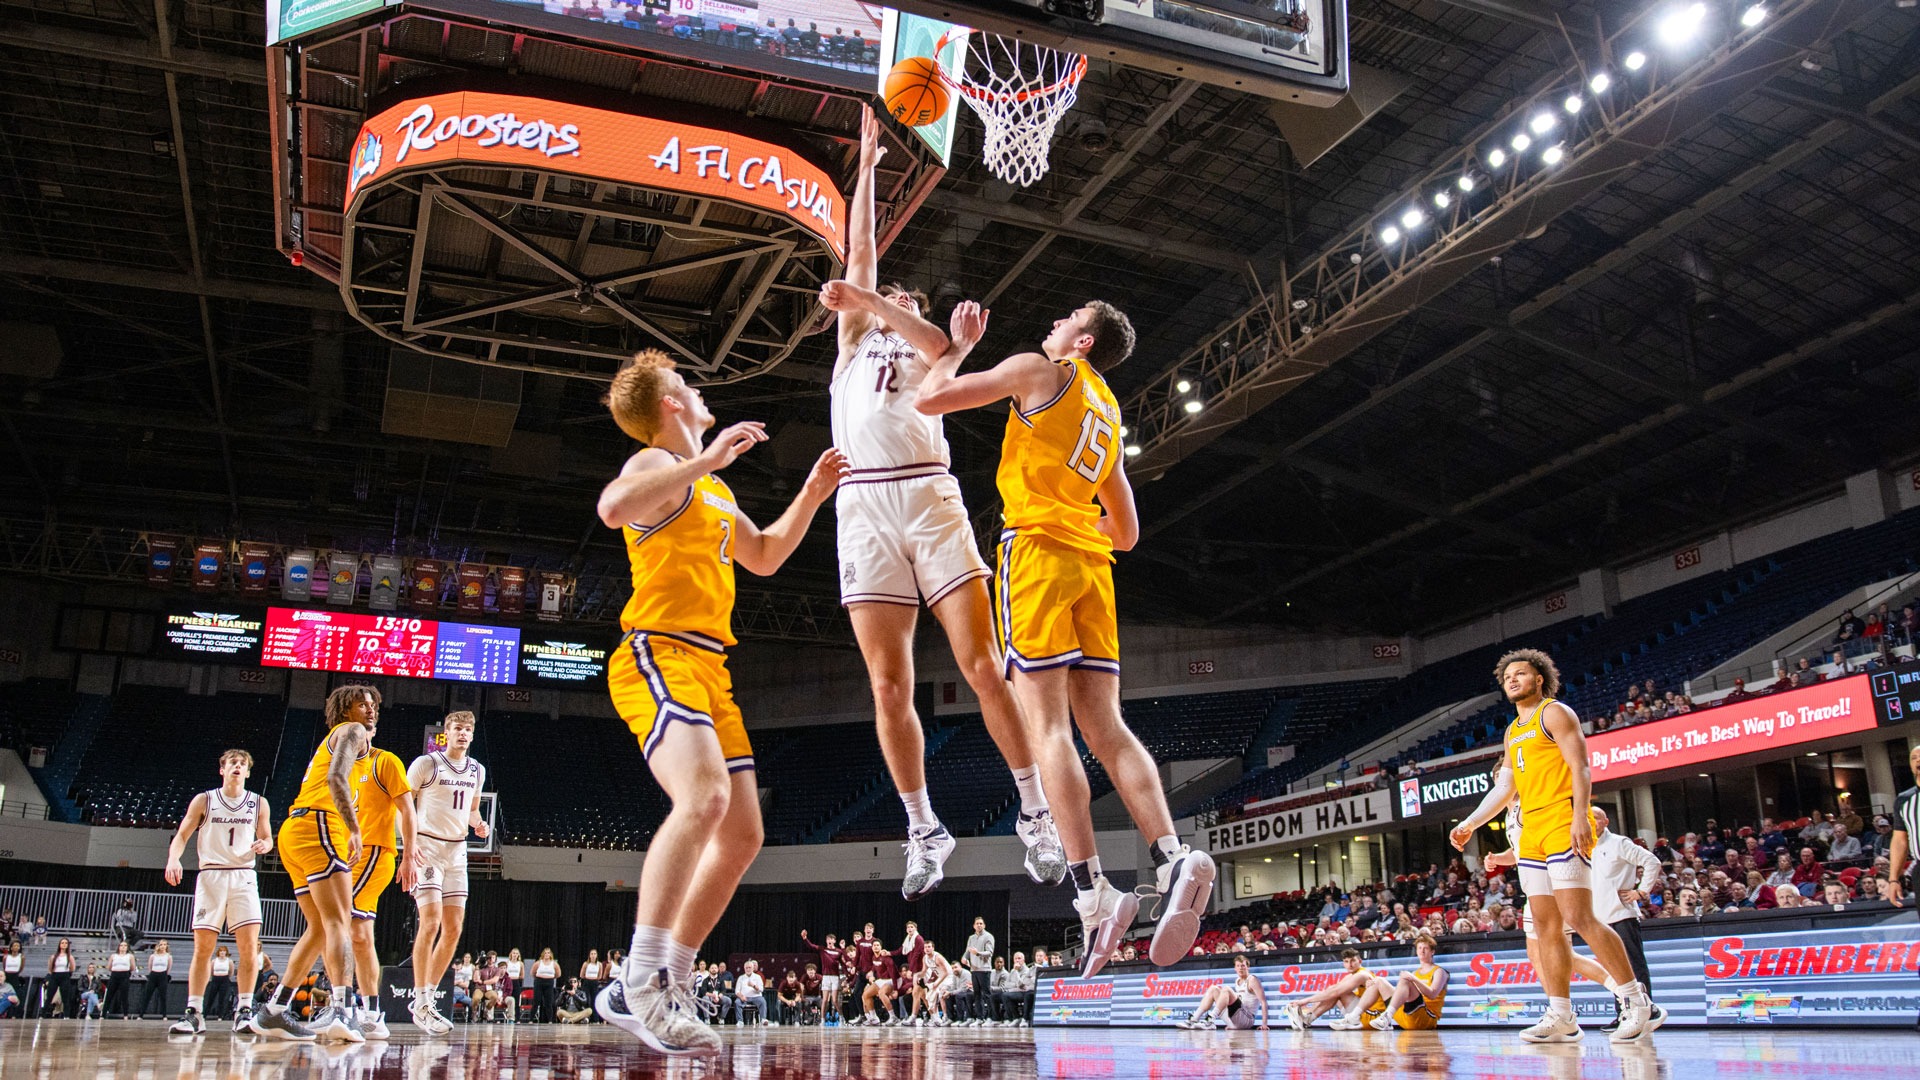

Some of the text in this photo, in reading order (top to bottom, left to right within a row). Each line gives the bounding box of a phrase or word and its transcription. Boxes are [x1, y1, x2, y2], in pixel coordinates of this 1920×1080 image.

[648, 136, 680, 173] A
[738, 156, 836, 233] CASUAL
[875, 361, 898, 393] 12
[1066, 408, 1113, 484] 15
[720, 519, 730, 566] 2
[1677, 551, 1700, 568] 331
[548, 591, 554, 600] 3
[1546, 596, 1566, 612] 330
[168, 616, 261, 630] FITNESS MARKET
[375, 616, 421, 632] 13:10
[167, 631, 202, 639] LOUISVILLE'S
[215, 640, 251, 648] COMMERCIAL
[358, 637, 379, 651] 10
[411, 640, 431, 654] 14
[524, 644, 606, 658] FITNESS MARKET
[1374, 645, 1400, 657] 329
[0, 649, 20, 664] 321
[566, 668, 598, 676] COMMERCIAL
[1190, 662, 1213, 673] 328
[240, 671, 264, 682] 322
[1899, 673, 1912, 684] TM
[507, 691, 530, 701] 324
[1592, 698, 1851, 770] By Knights, It's The Best Way To Travel!
[1517, 746, 1525, 773] 4
[439, 779, 475, 788] BELLARMINE
[1422, 772, 1489, 803] KNIGHTS
[453, 790, 464, 810] 11
[1209, 797, 1377, 851] FREEDOM HALL
[229, 827, 235, 846] 1
[1051, 979, 1114, 1001] STERNBERG
